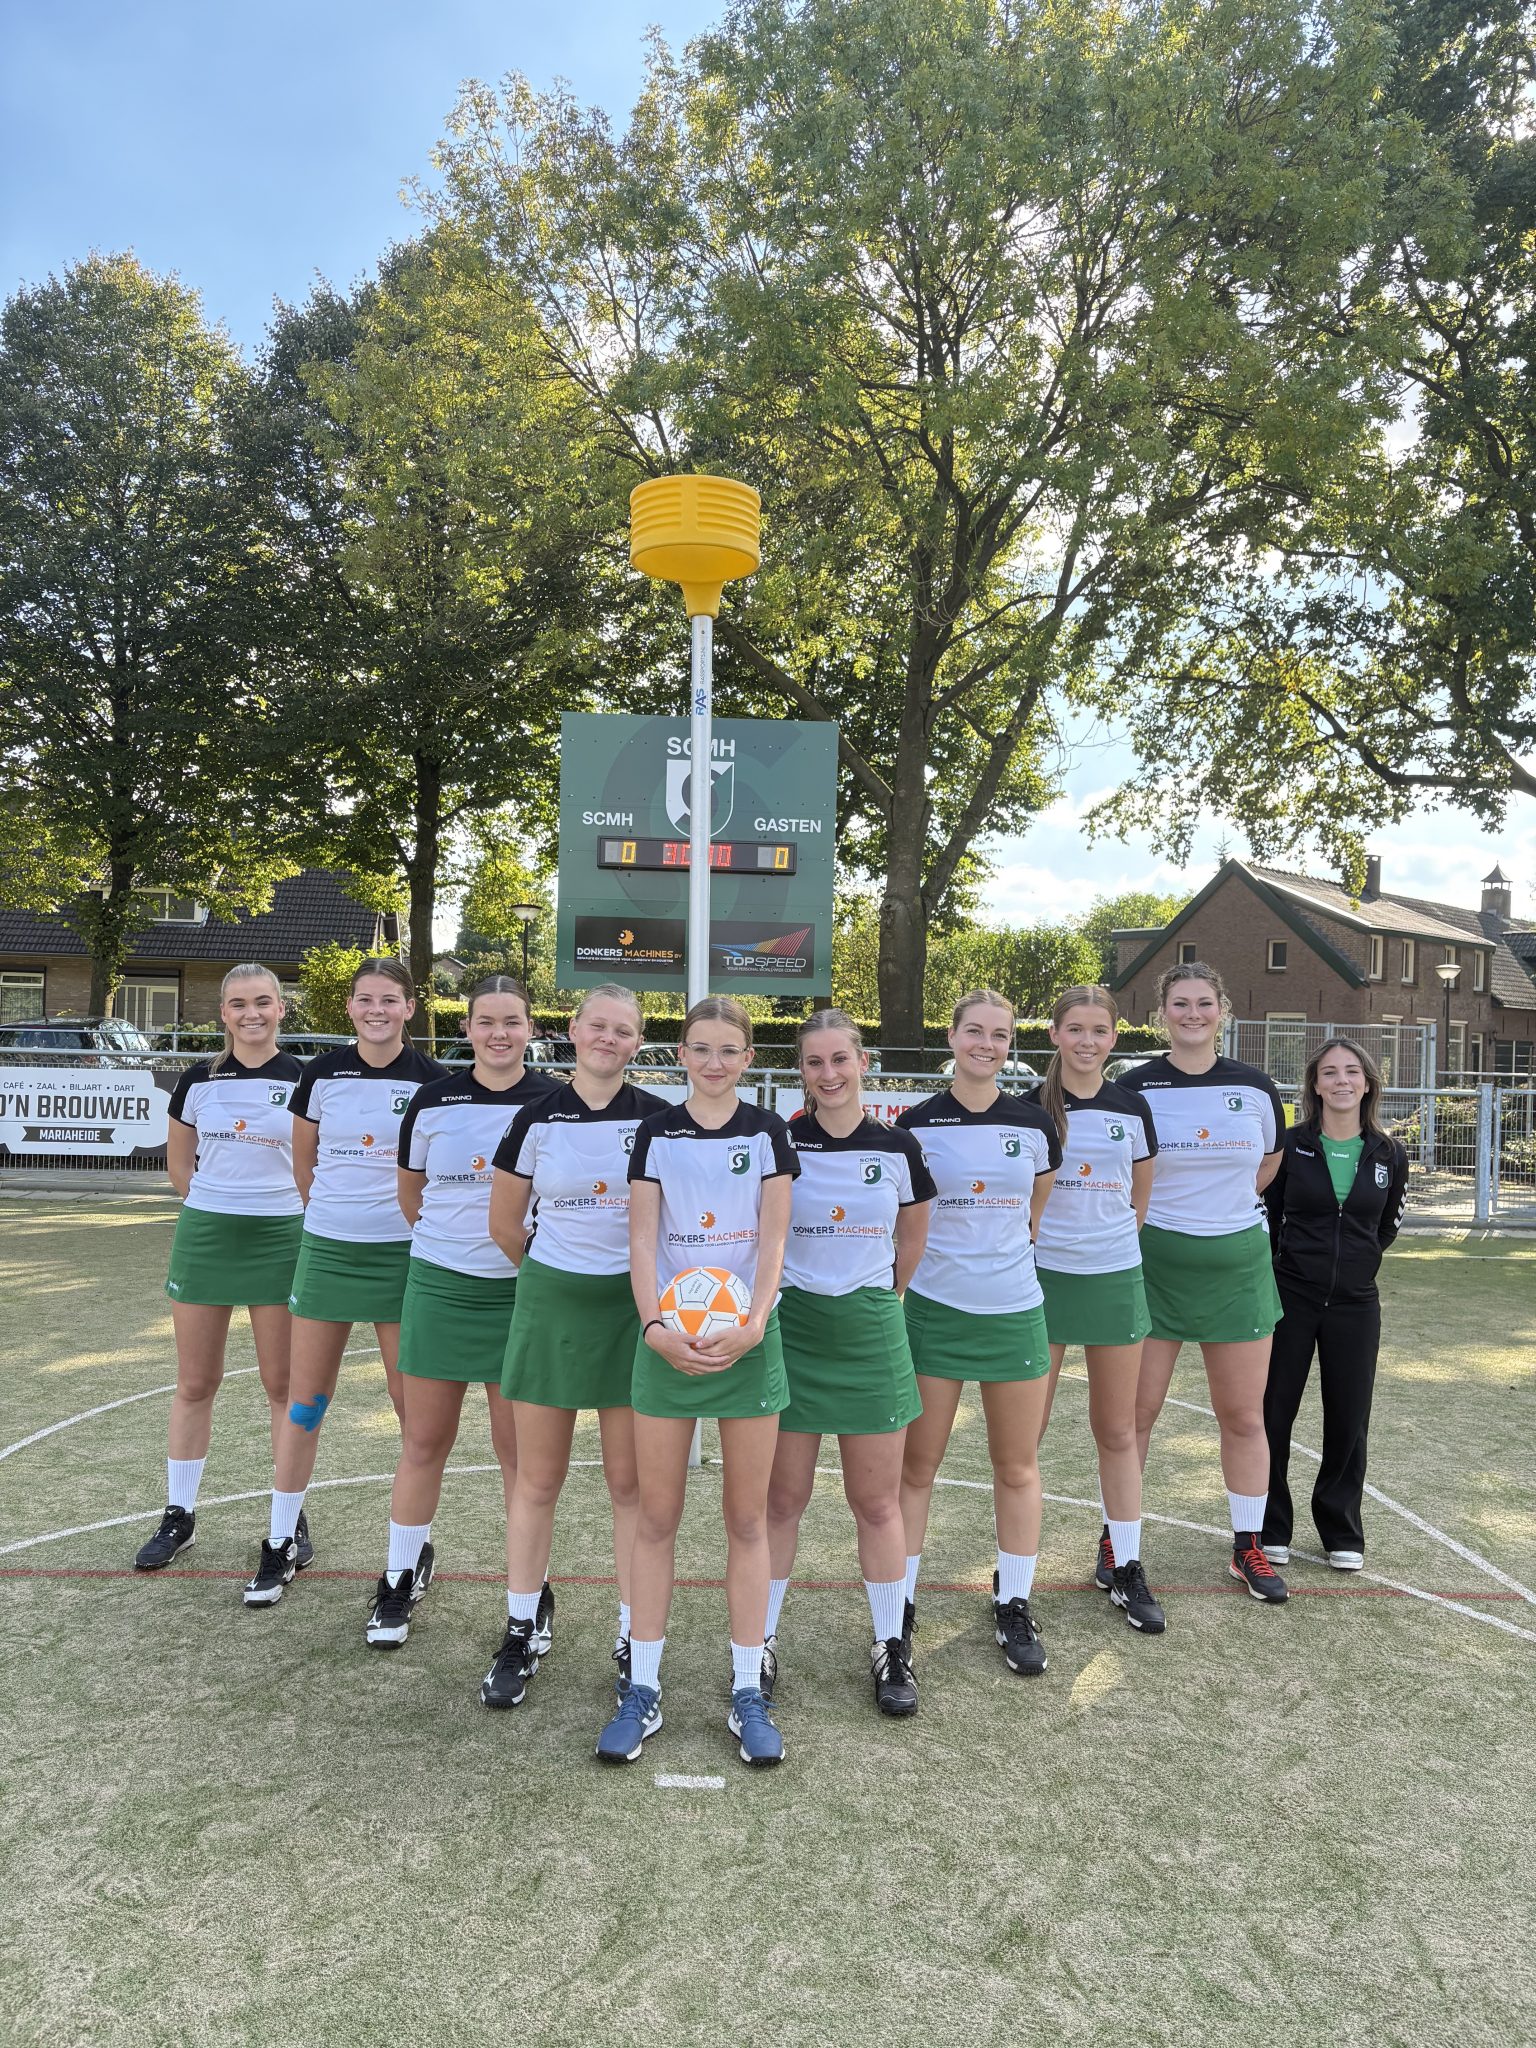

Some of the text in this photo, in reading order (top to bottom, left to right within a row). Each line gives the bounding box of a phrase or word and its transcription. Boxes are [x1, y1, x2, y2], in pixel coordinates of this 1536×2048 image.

[694, 688, 706, 716] RAS
[582, 811, 633, 827] SCMH
[754, 817, 822, 833] GASTEN
[622, 841, 636, 863] 0
[775, 847, 789, 869] 0
[577, 947, 623, 957] DONKERS
[624, 949, 674, 959] MACHINES
[722, 956, 807, 968] TOPSPEED
[3, 1081, 25, 1090] CAFÉ
[441, 1094, 473, 1102] STANNO
[37, 1095, 150, 1121] BROUWER
[548, 1112, 580, 1120] STANNO
[39, 1129, 101, 1141] MARIAHEIDE
[238, 1133, 281, 1147] MACHINES
[727, 1144, 750, 1152] SCMH
[795, 1141, 823, 1149] TANNO
[436, 1174, 476, 1182] DONKERS
[1083, 1181, 1123, 1189] MACHINES
[554, 1198, 597, 1208] DONKERS
[977, 1197, 1021, 1205] MACHINES
[707, 1229, 754, 1242] MACHINES
[793, 1225, 835, 1234] DONKERS
[837, 1226, 884, 1235] MACHINES
